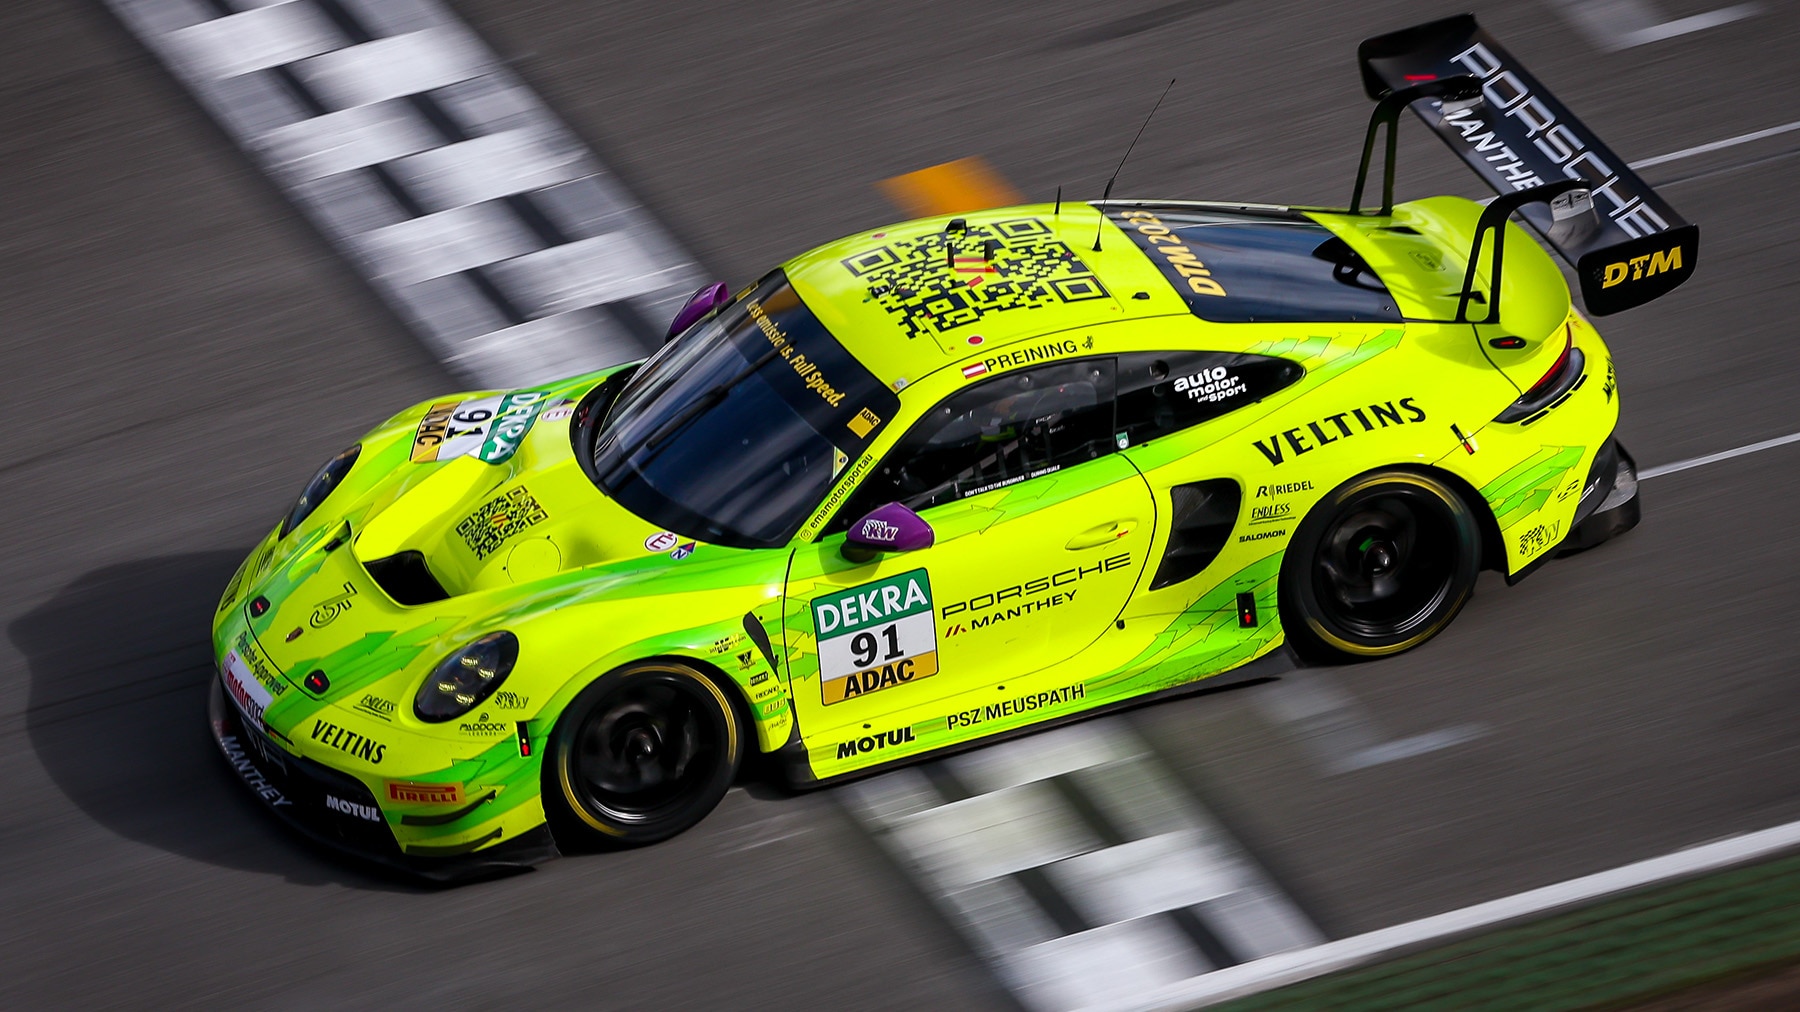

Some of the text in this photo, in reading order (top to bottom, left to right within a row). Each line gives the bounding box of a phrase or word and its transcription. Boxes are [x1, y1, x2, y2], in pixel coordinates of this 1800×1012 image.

[1431, 100, 1546, 191] ANTHE
[1450, 42, 1670, 239] PORSCHE
[1157, 246, 1227, 297] DTM
[1602, 245, 1682, 289] DTM
[984, 340, 1078, 372] PREINING
[789, 354, 817, 377] Full
[805, 370, 846, 408] Speed.
[1173, 366, 1227, 392] auto
[1188, 376, 1239, 399] motor
[1208, 383, 1247, 402] sport
[445, 409, 493, 441] 91
[860, 409, 879, 427] ADAC
[1252, 397, 1427, 467] VELTINS
[809, 453, 874, 530] emamotorsportau
[1276, 480, 1315, 495] RIEDEL
[1251, 503, 1291, 518] ENDLESS
[1239, 529, 1286, 543] SALOMON
[816, 578, 929, 634] DEKRA
[942, 552, 1131, 620] PORSCHE
[971, 589, 1077, 630] MANTHEY
[850, 623, 905, 668] 91
[843, 659, 915, 699] ADAC
[946, 683, 1086, 731] PSZ MEUSPATH
[310, 719, 387, 765] VELTINS
[836, 725, 916, 760] MOTUL
[219, 735, 293, 806] MANTHEY
[326, 794, 381, 822] MOTUL
[389, 783, 457, 802] PIRELLI
